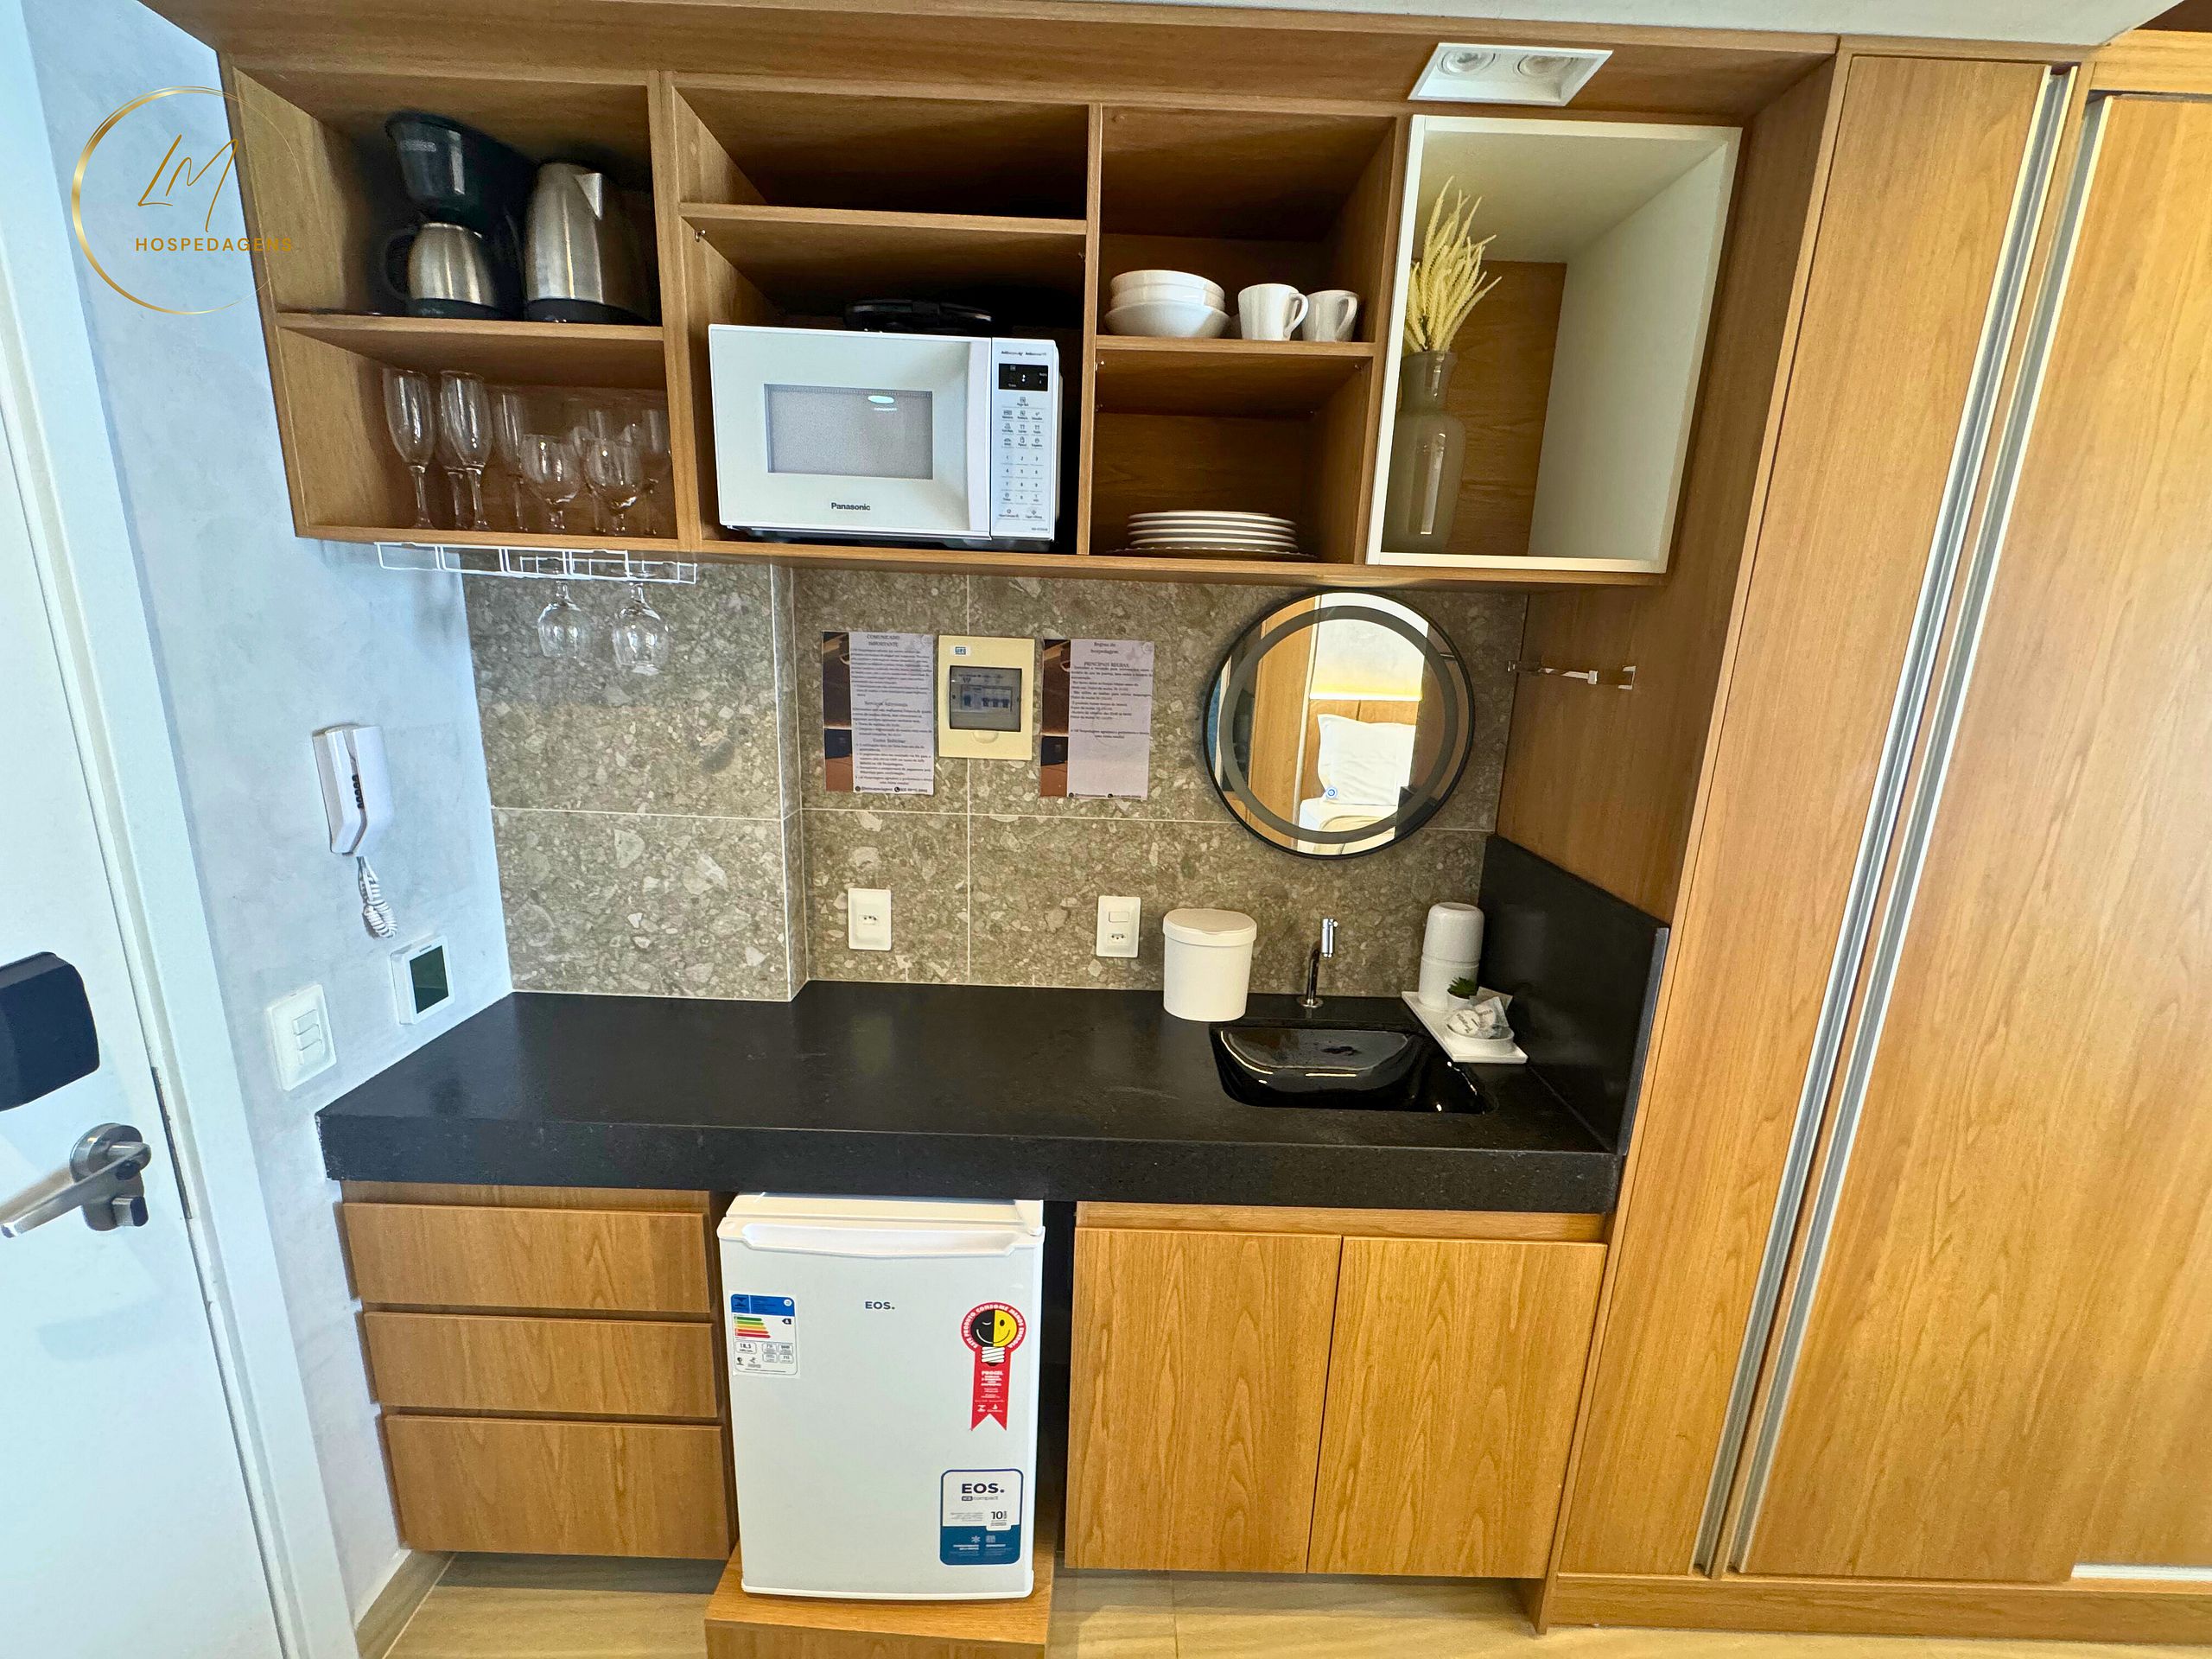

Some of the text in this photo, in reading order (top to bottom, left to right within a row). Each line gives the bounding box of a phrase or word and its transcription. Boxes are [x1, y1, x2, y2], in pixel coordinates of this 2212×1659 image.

[830, 502, 871, 512] Panasonic
[865, 1300, 895, 1310] EOS.
[963, 1312, 976, 1338] PRODUTO
[976, 1304, 1009, 1313] CONSOME
[1008, 1308, 1025, 1326] MENOS
[961, 1483, 1005, 1494] EOS.
[990, 1510, 1003, 1520] 10
